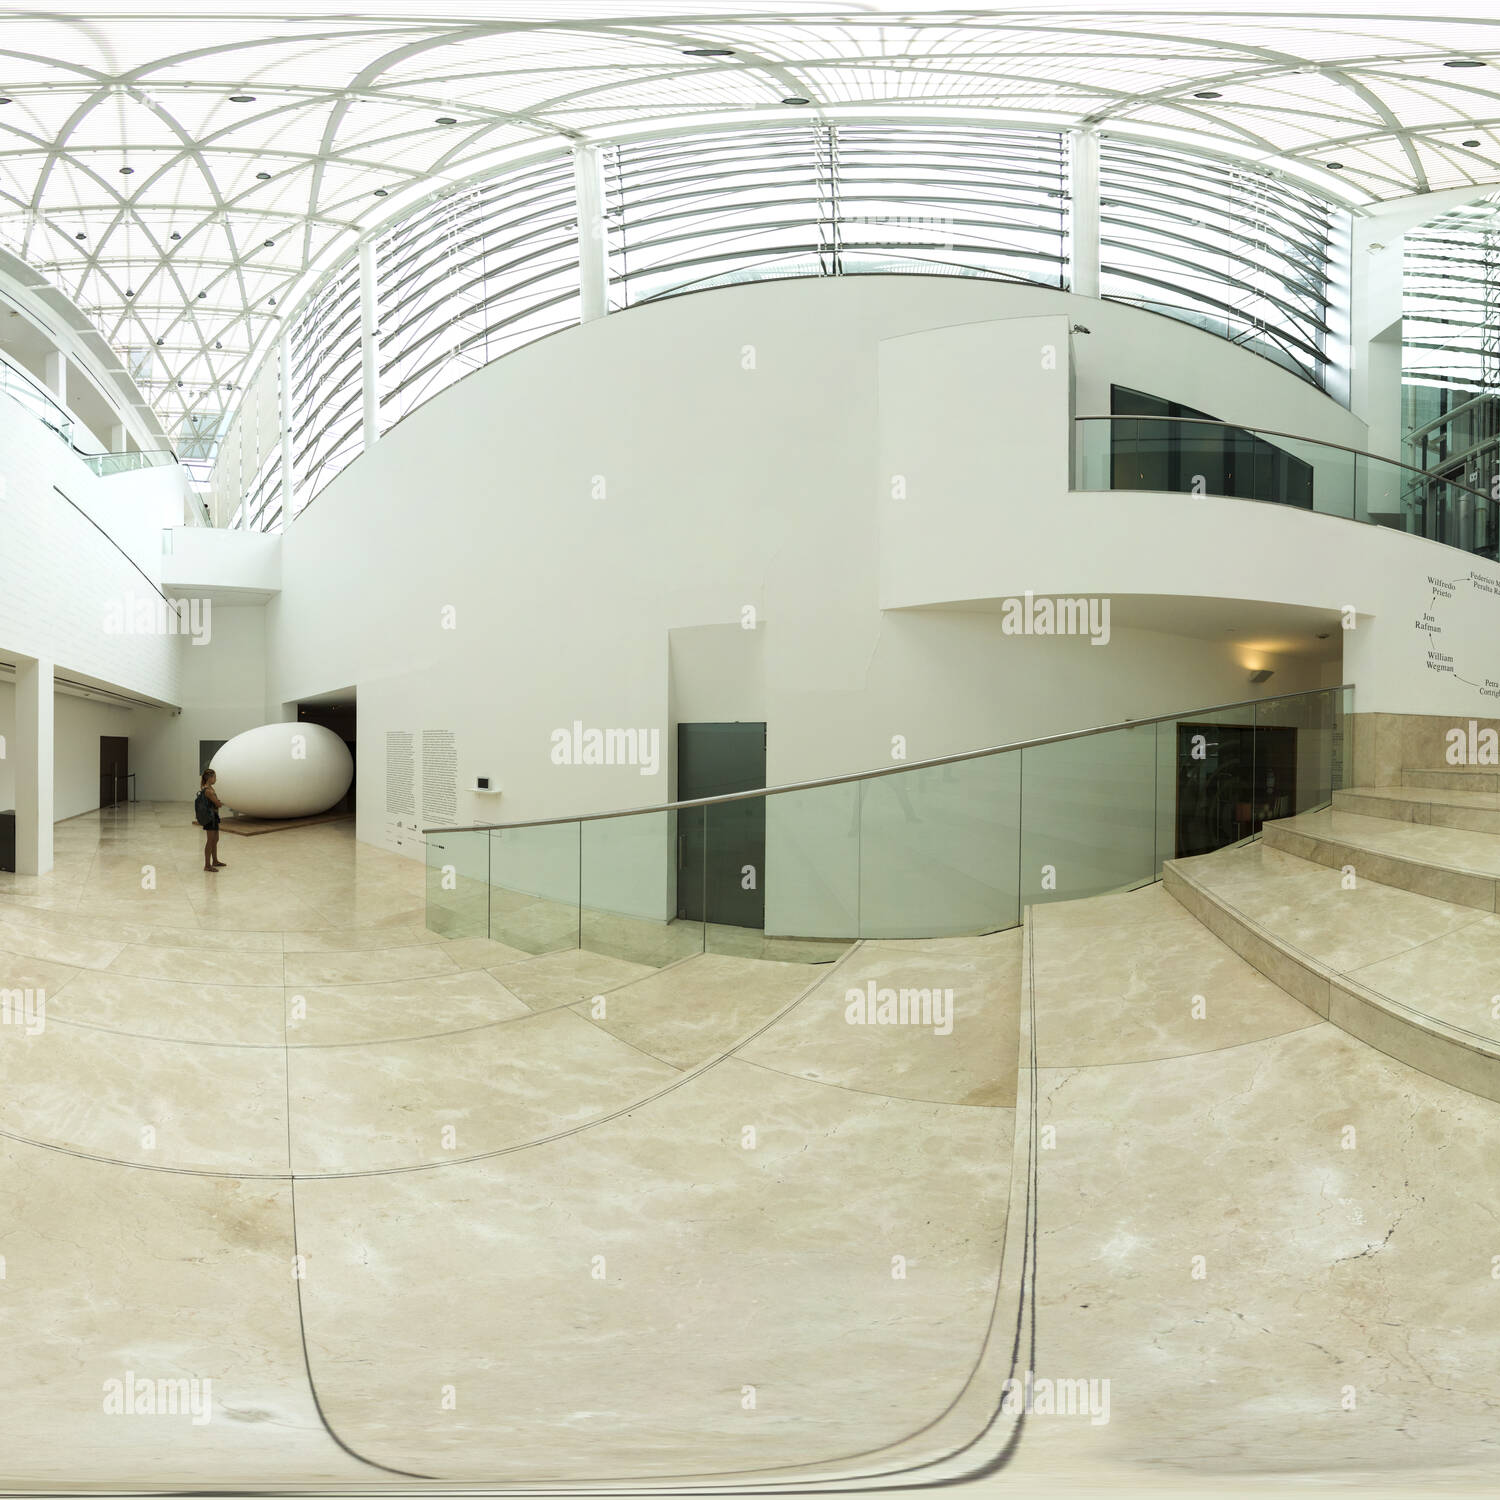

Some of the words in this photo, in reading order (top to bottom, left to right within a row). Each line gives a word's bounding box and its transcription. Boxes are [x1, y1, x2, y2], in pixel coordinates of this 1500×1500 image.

[1427, 576, 1455, 590] Wilfredo
[1432, 587, 1452, 599] Prieto
[1423, 612, 1435, 622] Jon
[1415, 620, 1441, 632] Rafman
[1427, 651, 1454, 663] William
[1426, 661, 1454, 672] Wegman
[1485, 679, 1499, 688] Petra
